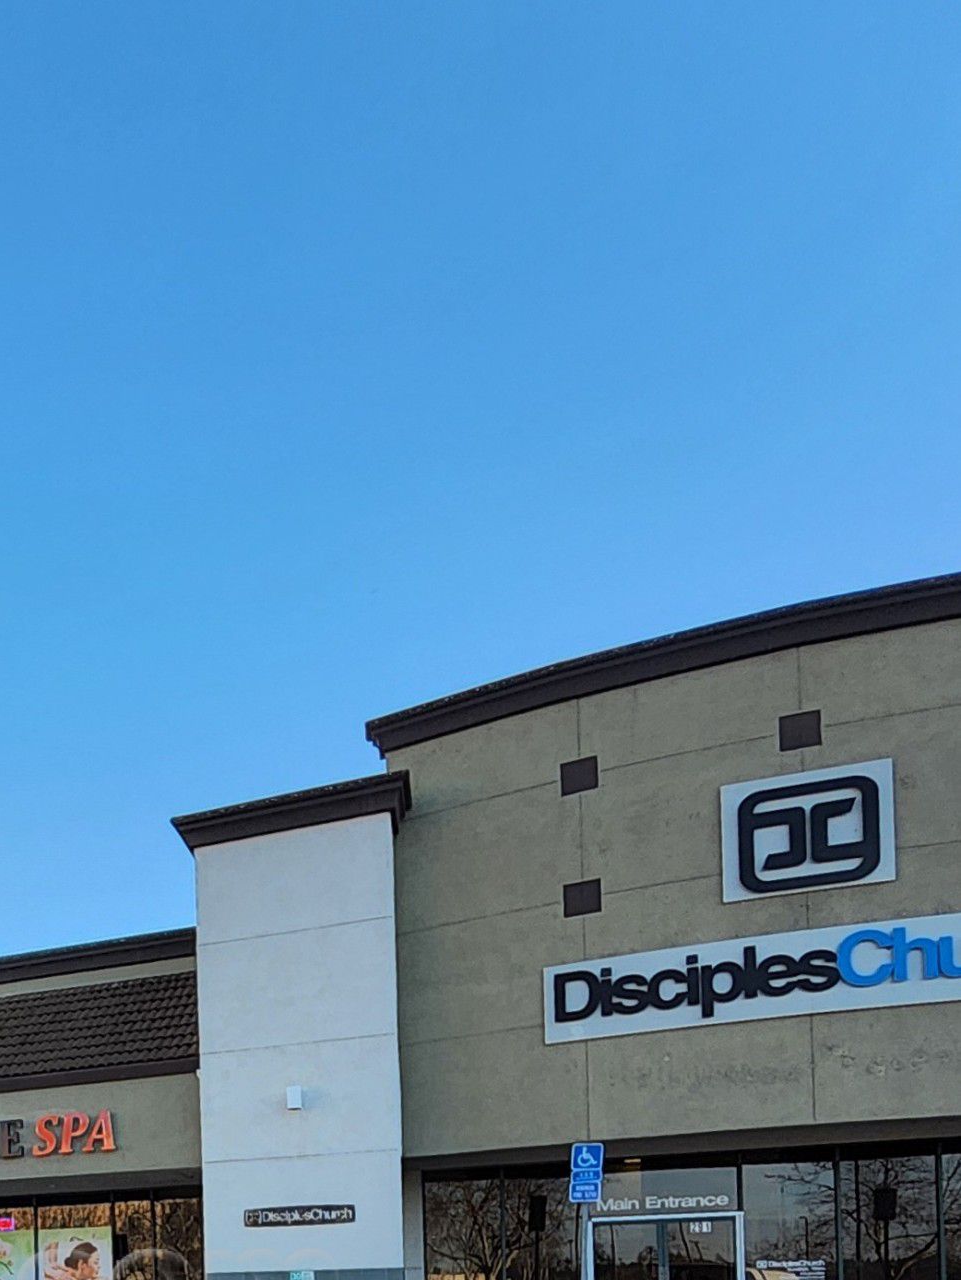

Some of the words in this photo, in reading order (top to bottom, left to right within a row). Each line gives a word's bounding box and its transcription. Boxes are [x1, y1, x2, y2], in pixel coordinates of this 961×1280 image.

[32, 1109, 118, 1158] SPA
[597, 1199, 639, 1211] Main
[645, 1195, 729, 1209] Entrance
